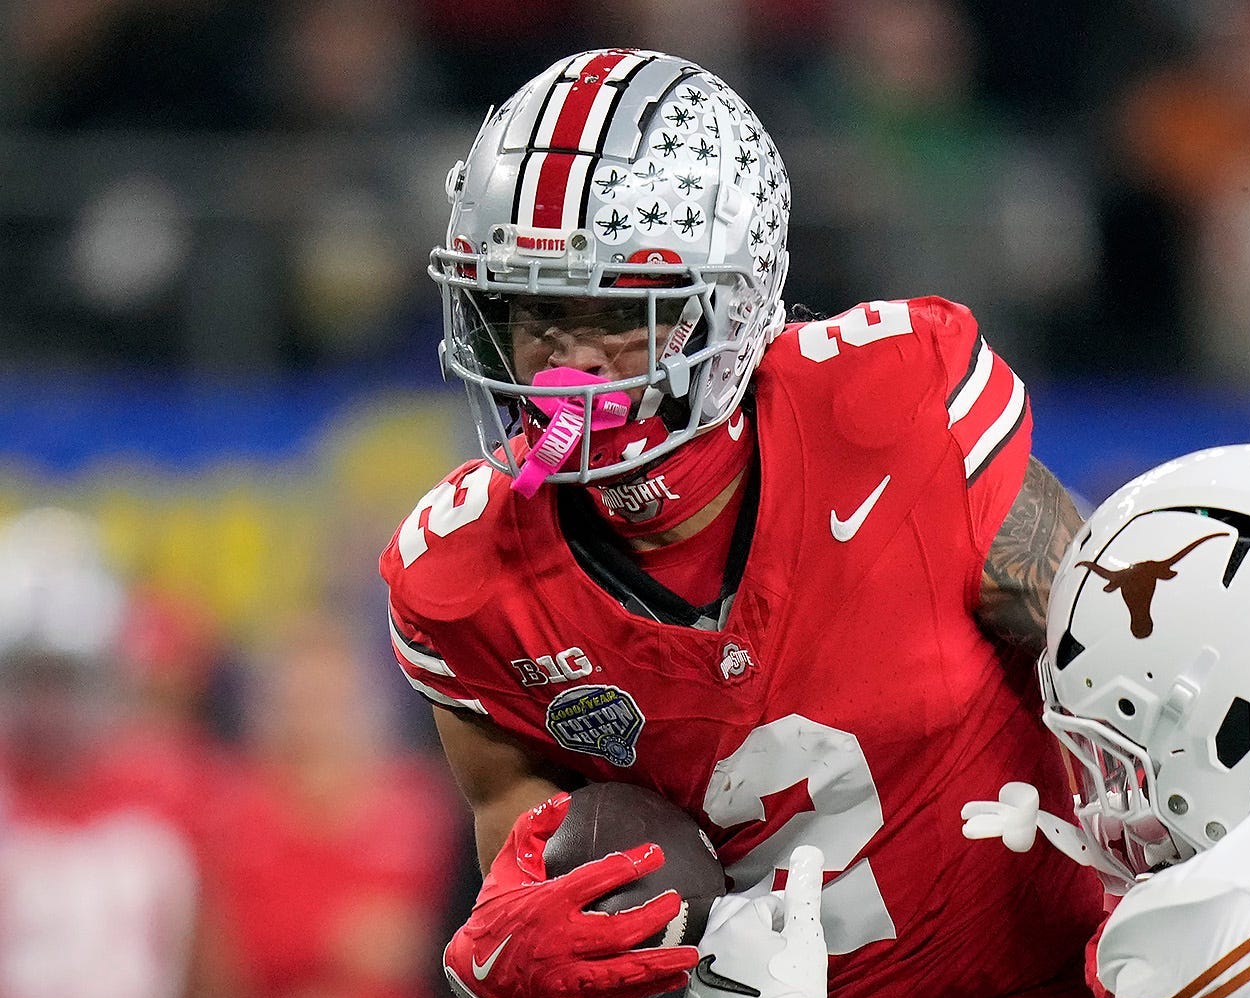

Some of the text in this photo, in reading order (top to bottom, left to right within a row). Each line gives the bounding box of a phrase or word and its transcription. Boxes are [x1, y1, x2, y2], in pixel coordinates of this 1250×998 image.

[536, 238, 566, 252] STATE
[797, 300, 914, 363] 2
[398, 464, 492, 570] 2
[703, 713, 898, 955] 2
